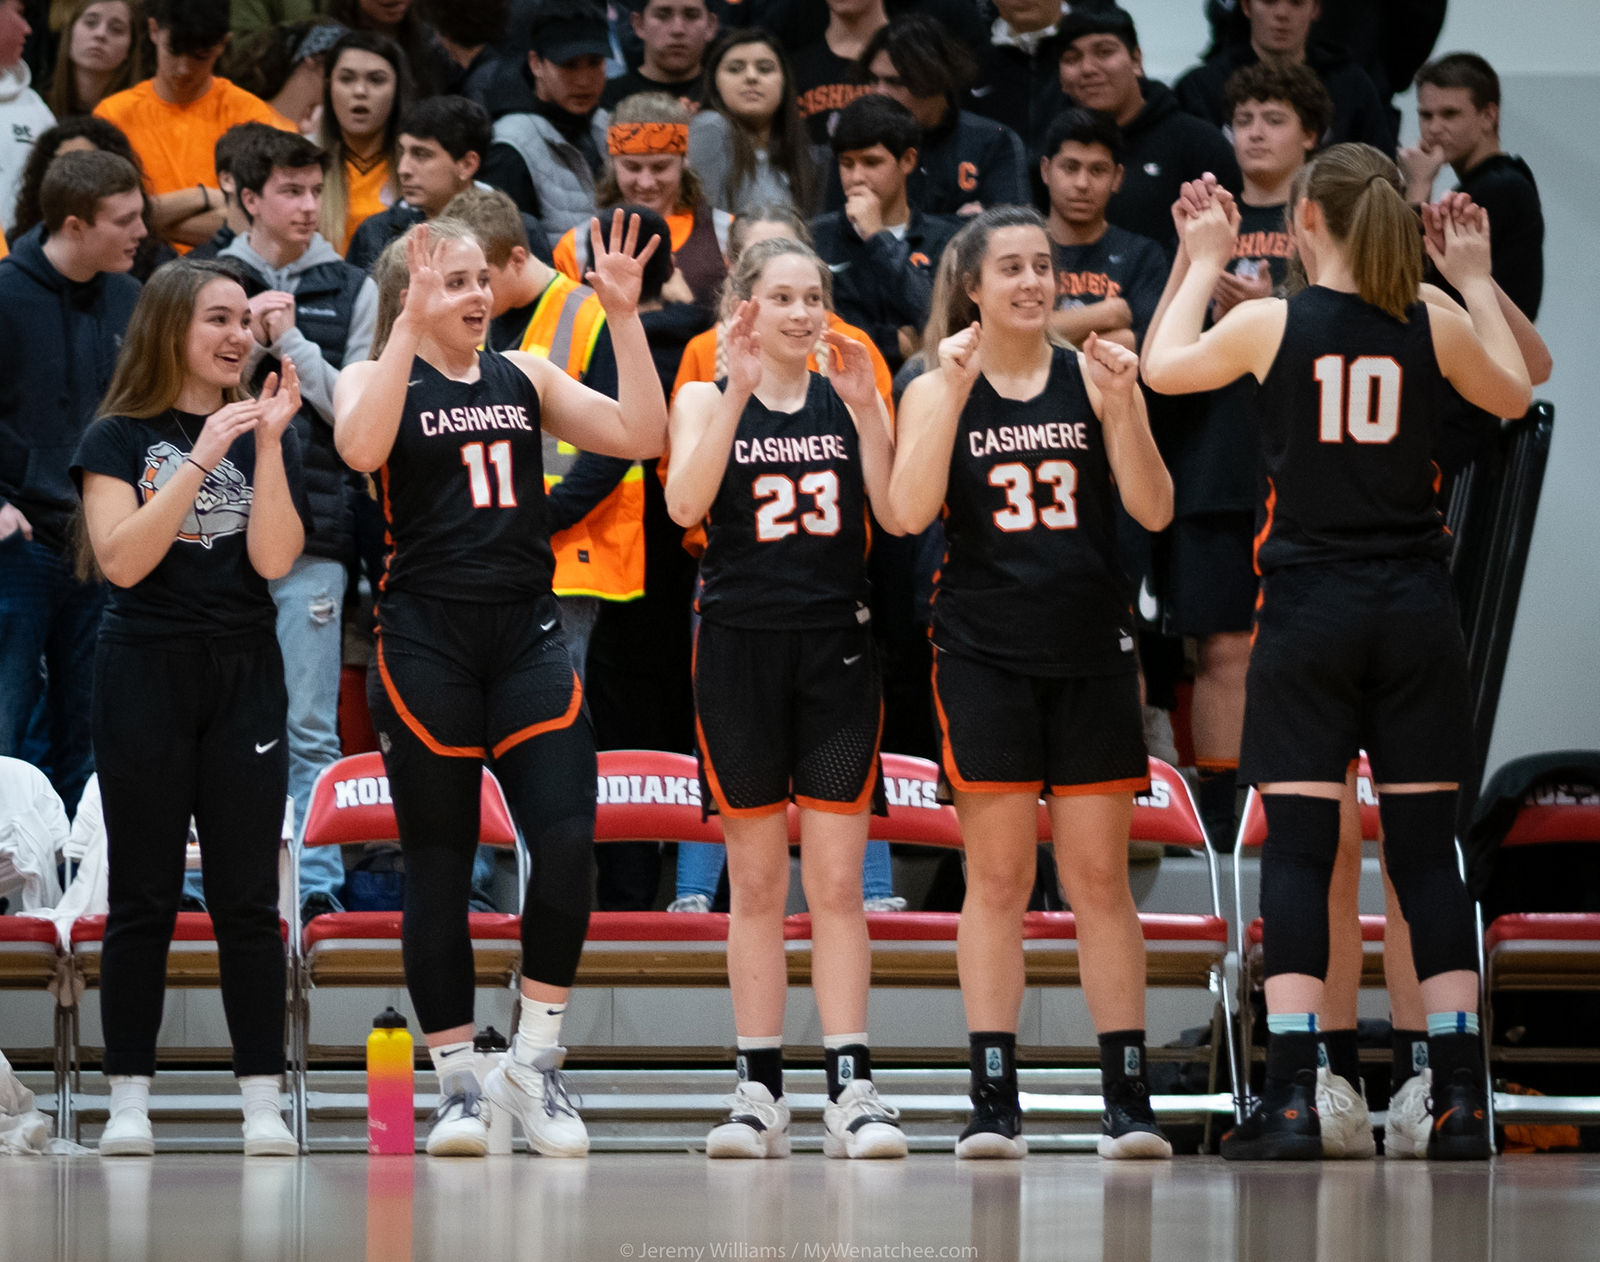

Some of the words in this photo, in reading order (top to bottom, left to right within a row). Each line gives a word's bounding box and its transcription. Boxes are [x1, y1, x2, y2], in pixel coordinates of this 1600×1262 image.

[958, 161, 978, 191] C
[420, 404, 533, 437] CASHMERE
[1313, 353, 1403, 444] 10
[734, 434, 849, 464] CASHMERE
[968, 421, 1089, 458] CASHMERE
[460, 439, 518, 509] 11
[987, 459, 1079, 533] 33
[751, 469, 842, 543] 23
